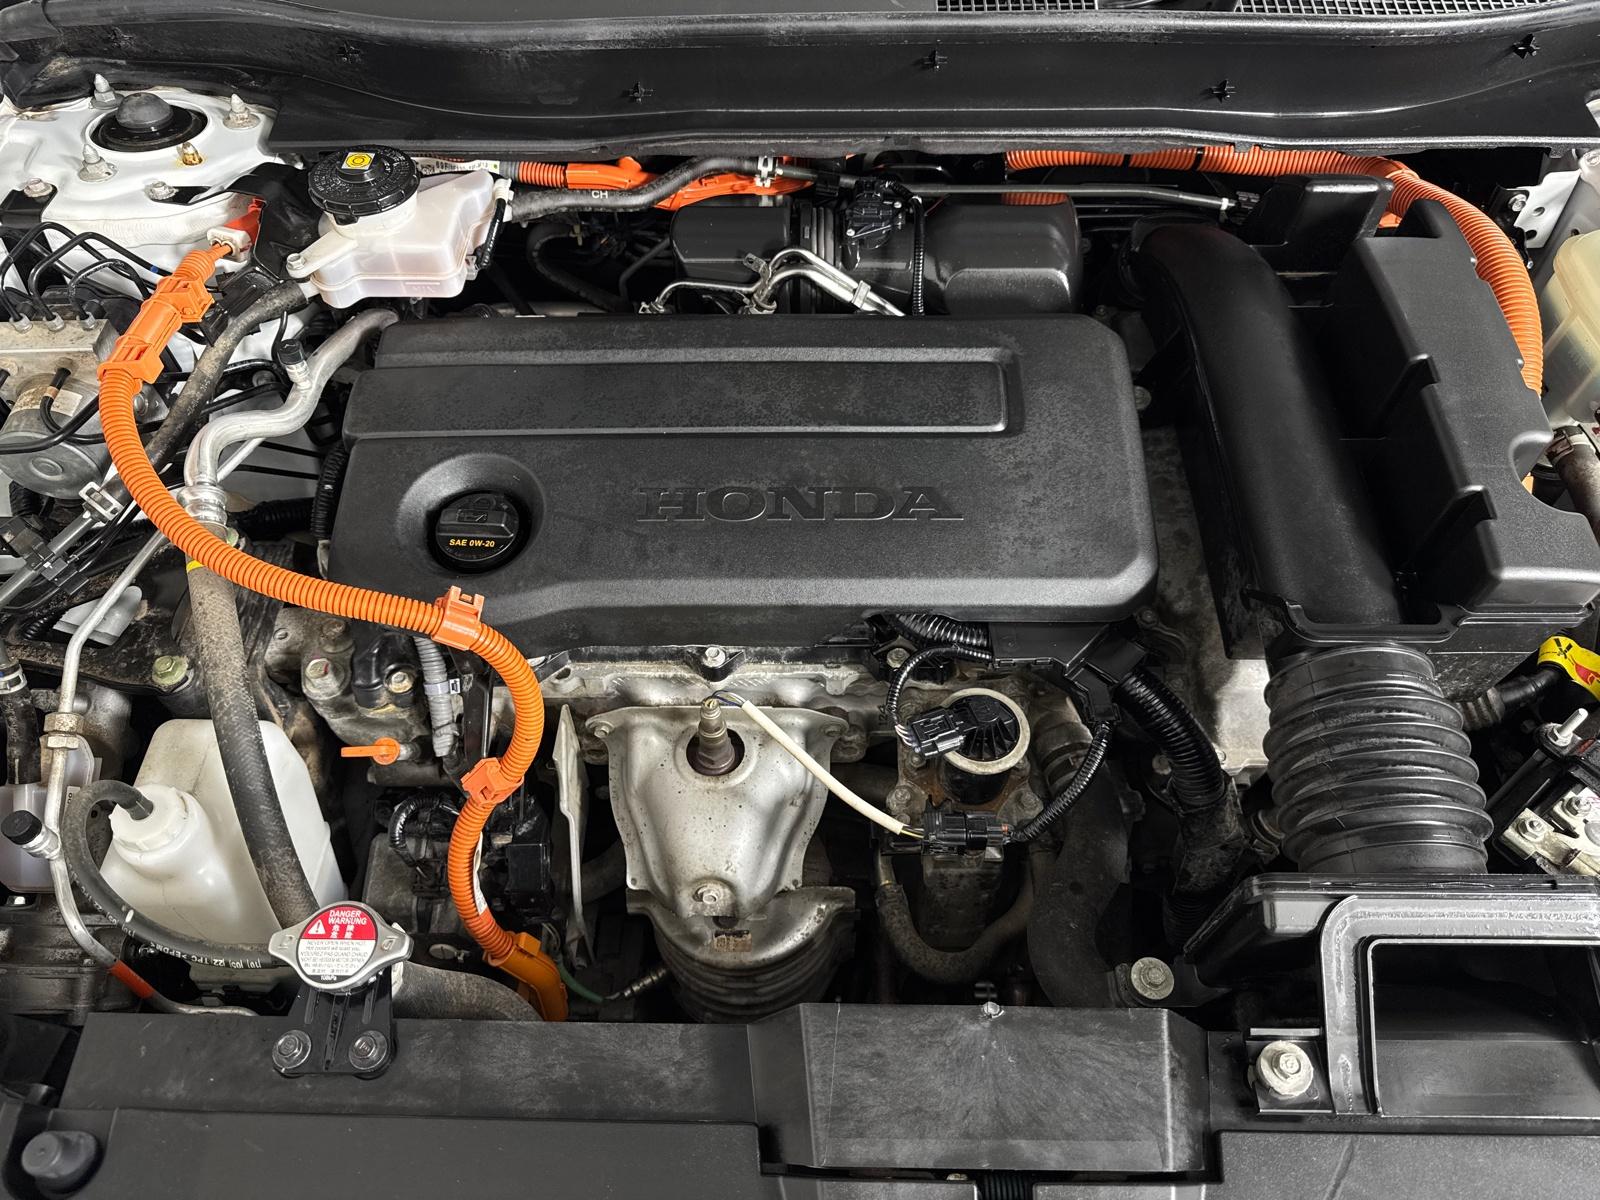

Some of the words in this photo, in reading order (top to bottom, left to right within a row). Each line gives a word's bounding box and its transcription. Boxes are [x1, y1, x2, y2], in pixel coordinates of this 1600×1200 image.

[591, 190, 608, 199] CH
[636, 487, 964, 521] HONDA
[449, 539, 467, 547] SAE
[469, 539, 495, 548] 0W-20
[329, 910, 361, 918] DANGER
[328, 917, 367, 925] WARNUNG
[191, 954, 209, 965] TPC
